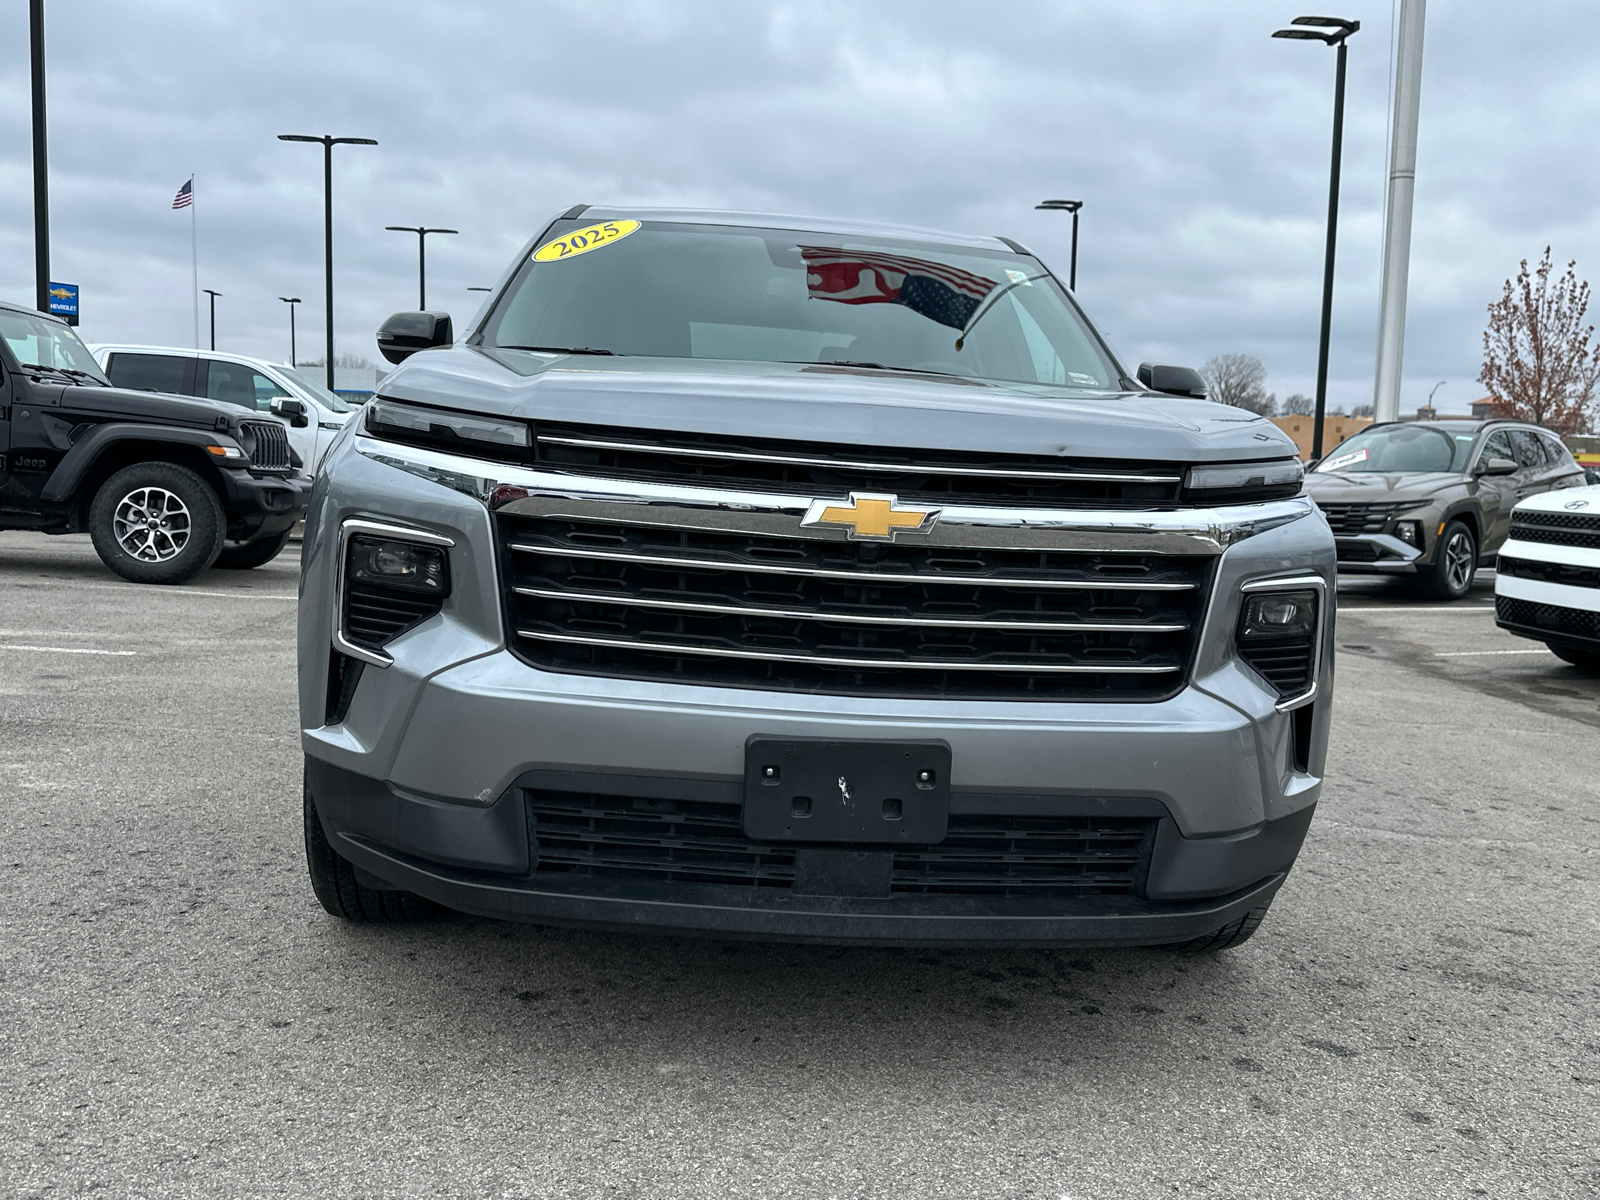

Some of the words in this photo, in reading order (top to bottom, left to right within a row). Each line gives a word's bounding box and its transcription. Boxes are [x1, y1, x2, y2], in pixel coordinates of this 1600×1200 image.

[552, 223, 620, 257] 2025
[50, 303, 77, 312] HEVROLET
[14, 456, 47, 469] Jeep
